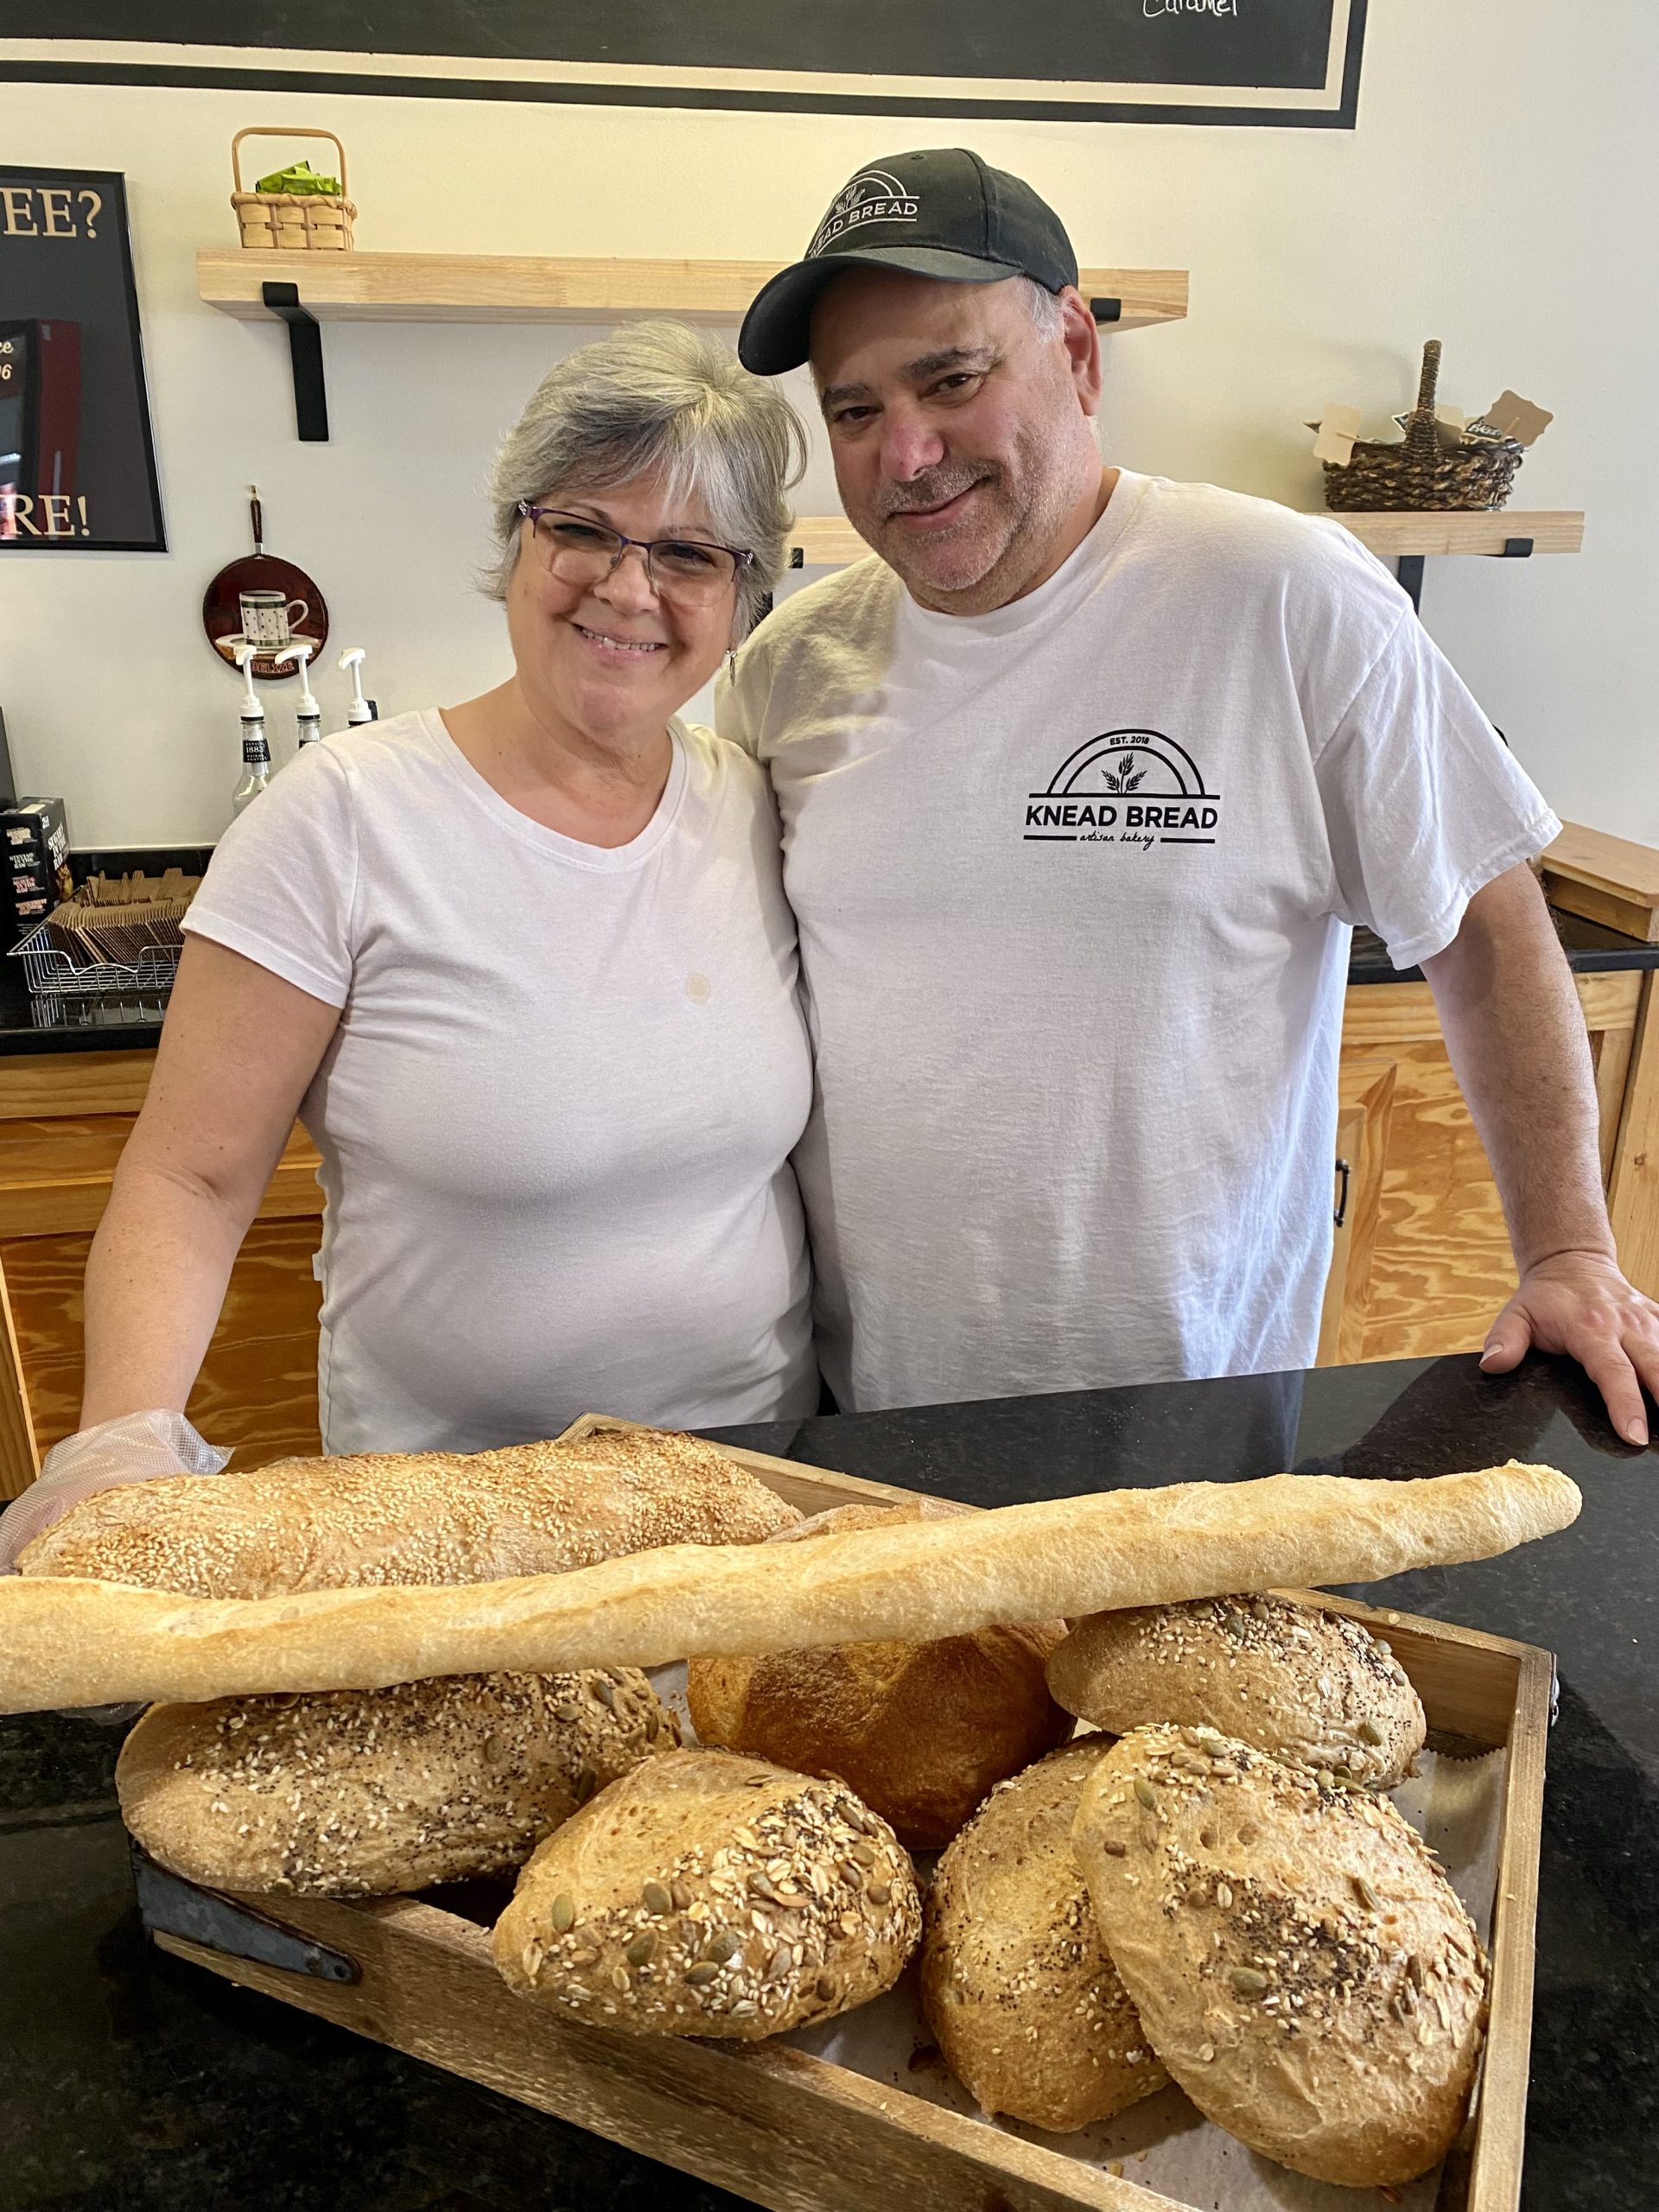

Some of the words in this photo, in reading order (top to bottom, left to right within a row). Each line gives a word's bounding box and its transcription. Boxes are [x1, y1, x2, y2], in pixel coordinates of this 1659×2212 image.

[849, 200, 918, 224] BREAD
[0, 493, 90, 537] RE!
[251, 660, 296, 673] BELIZE
[1109, 736, 1128, 745] EST.
[1130, 735, 1150, 745] 2018
[1026, 805, 1117, 827] KNEAD
[1126, 806, 1218, 830] BREAD
[1080, 830, 1115, 842] artisan
[1120, 831, 1154, 851] bakery
